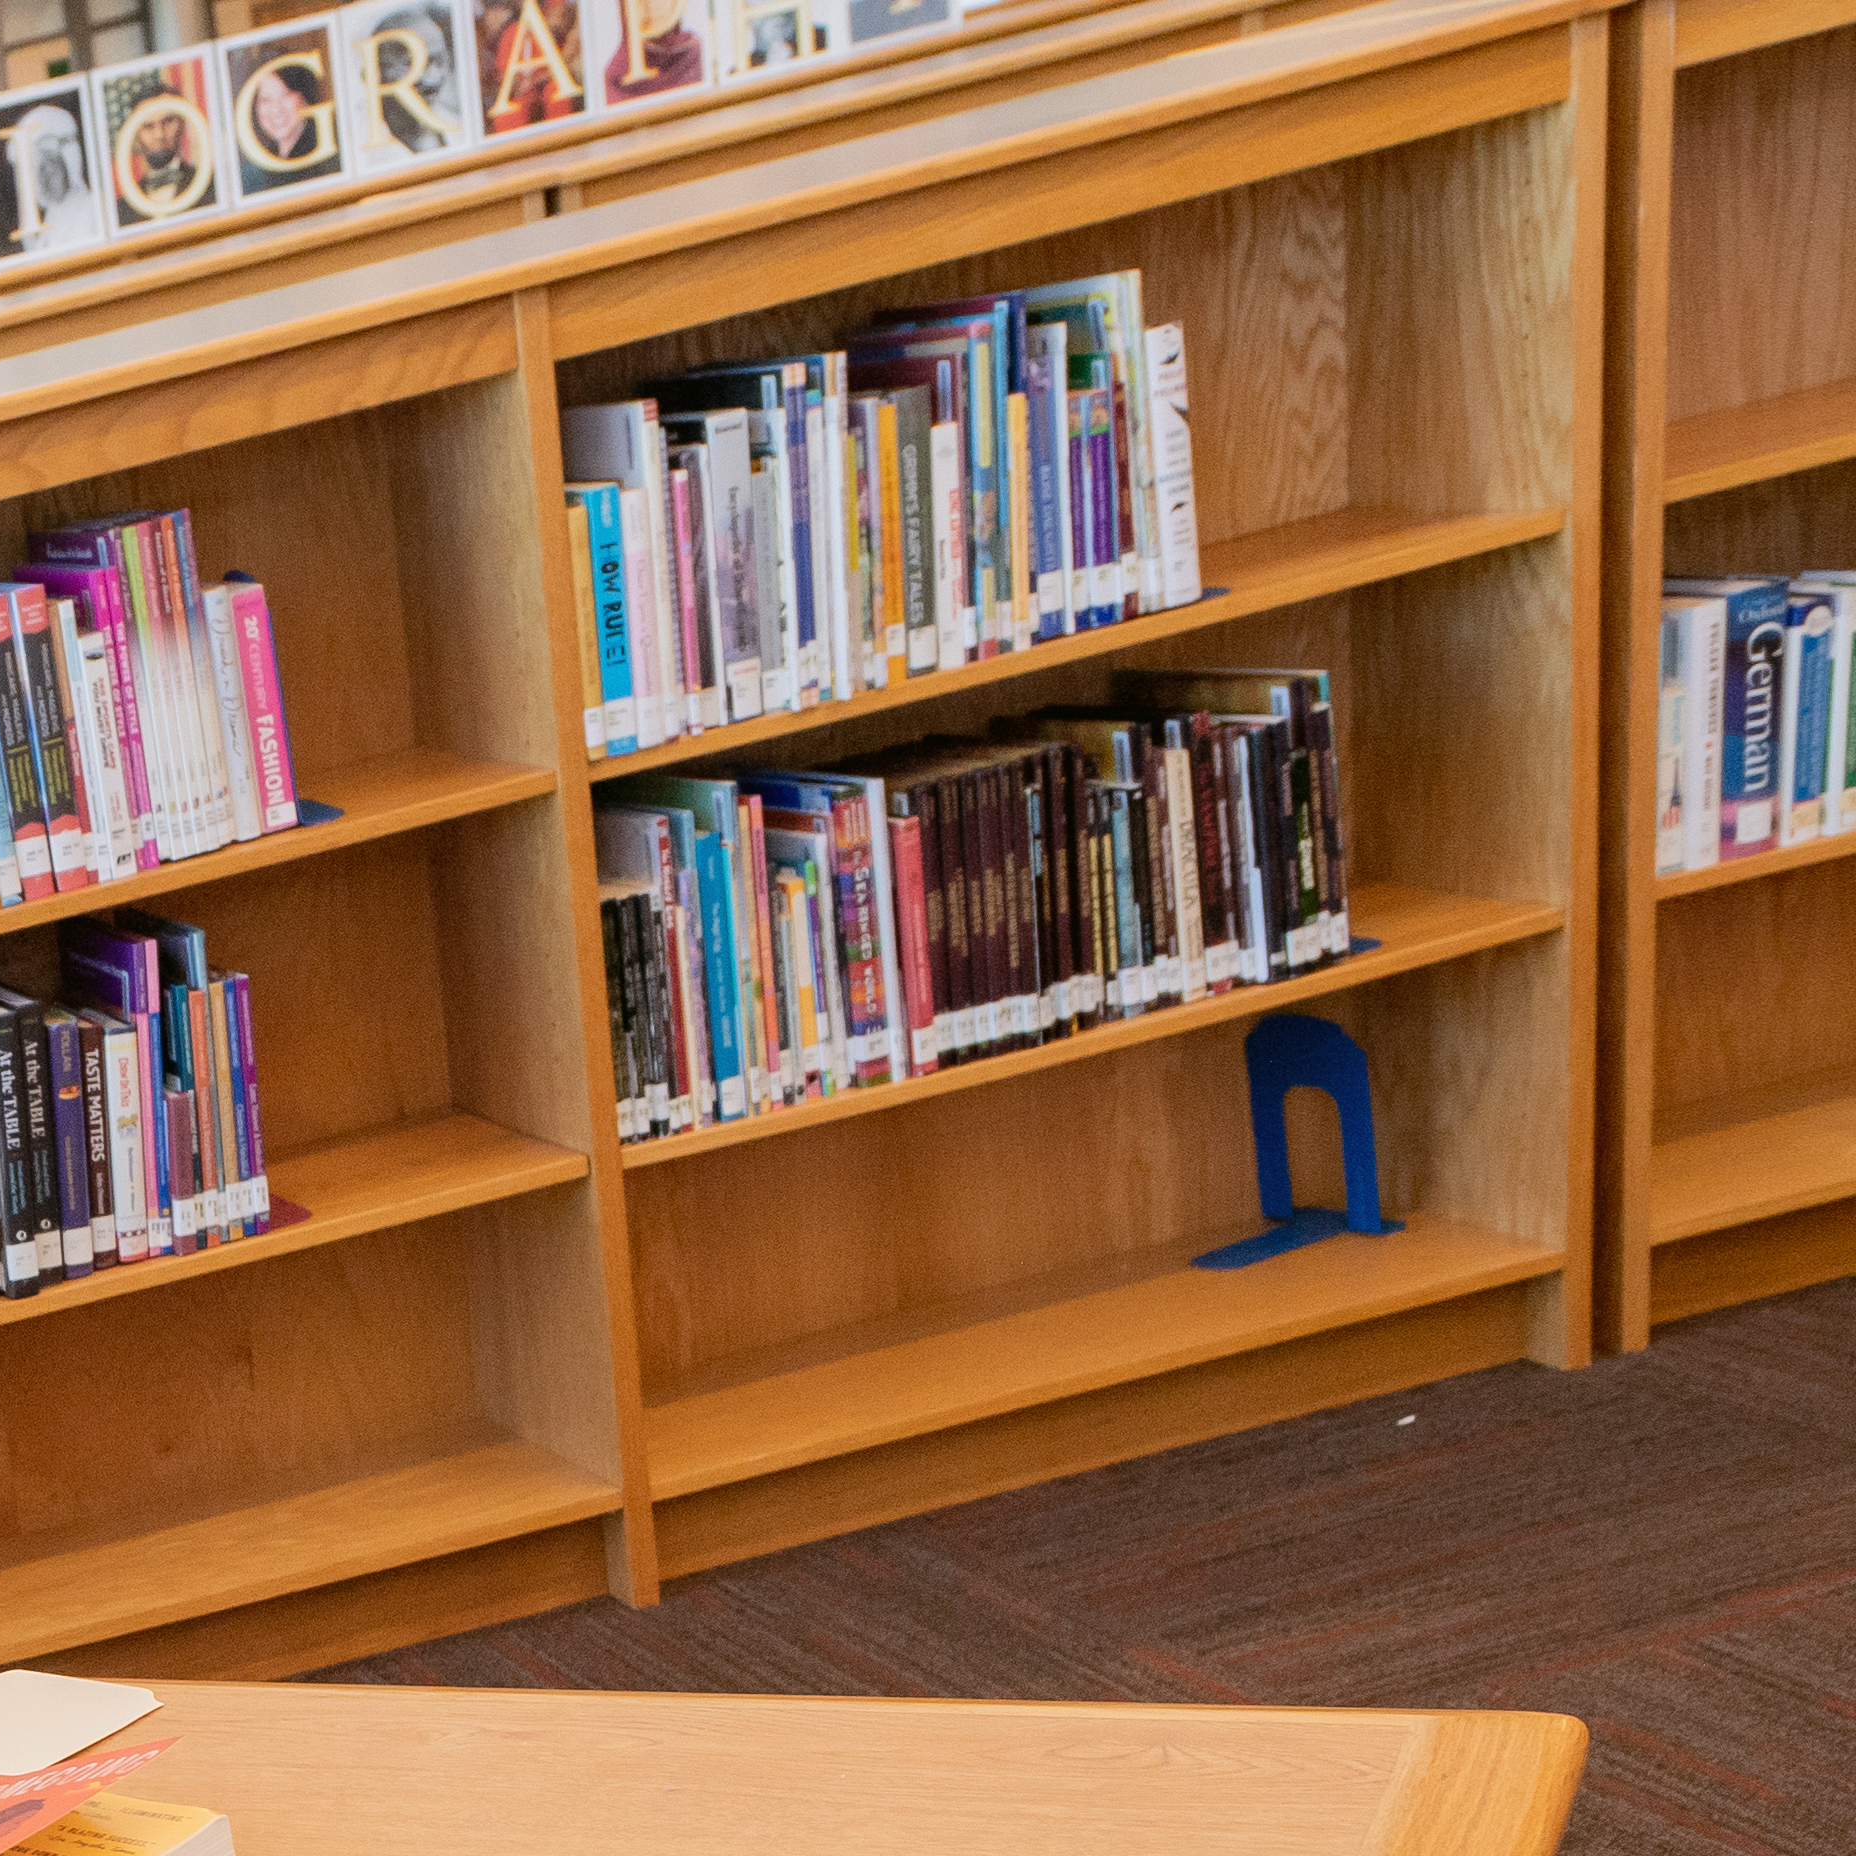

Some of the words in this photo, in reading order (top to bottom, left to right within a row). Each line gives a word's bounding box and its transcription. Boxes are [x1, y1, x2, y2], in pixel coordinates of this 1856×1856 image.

[905, 517, 923, 566] FAIRY
[598, 542, 620, 593] HOW
[907, 570, 925, 624] TALES
[113, 622, 125, 642] THE
[600, 601, 628, 666] RUDE!
[116, 644, 131, 681] POWER
[247, 643, 267, 710] CENTURY
[90, 681, 101, 704] YOU
[104, 646, 118, 686] POWER
[113, 704, 126, 738] STYLE
[122, 683, 133, 698] OF
[1743, 620, 1785, 794] German
[94, 706, 105, 735] MUST
[100, 701, 112, 740] SPORTS
[106, 742, 116, 770] CARS
[124, 700, 139, 736] STYLE
[99, 737, 110, 769] DRIVE
[254, 713, 286, 806] FASHION
[1177, 820, 1200, 909] DRACULA
[22, 1037, 39, 1057] At
[24, 1059, 42, 1084] the
[82, 1048, 103, 1093] TASTE
[0, 1068, 16, 1094] the
[0, 1095, 22, 1151] TABLE
[25, 1084, 47, 1139] TABLE
[85, 1093, 110, 1163] MATTERS
